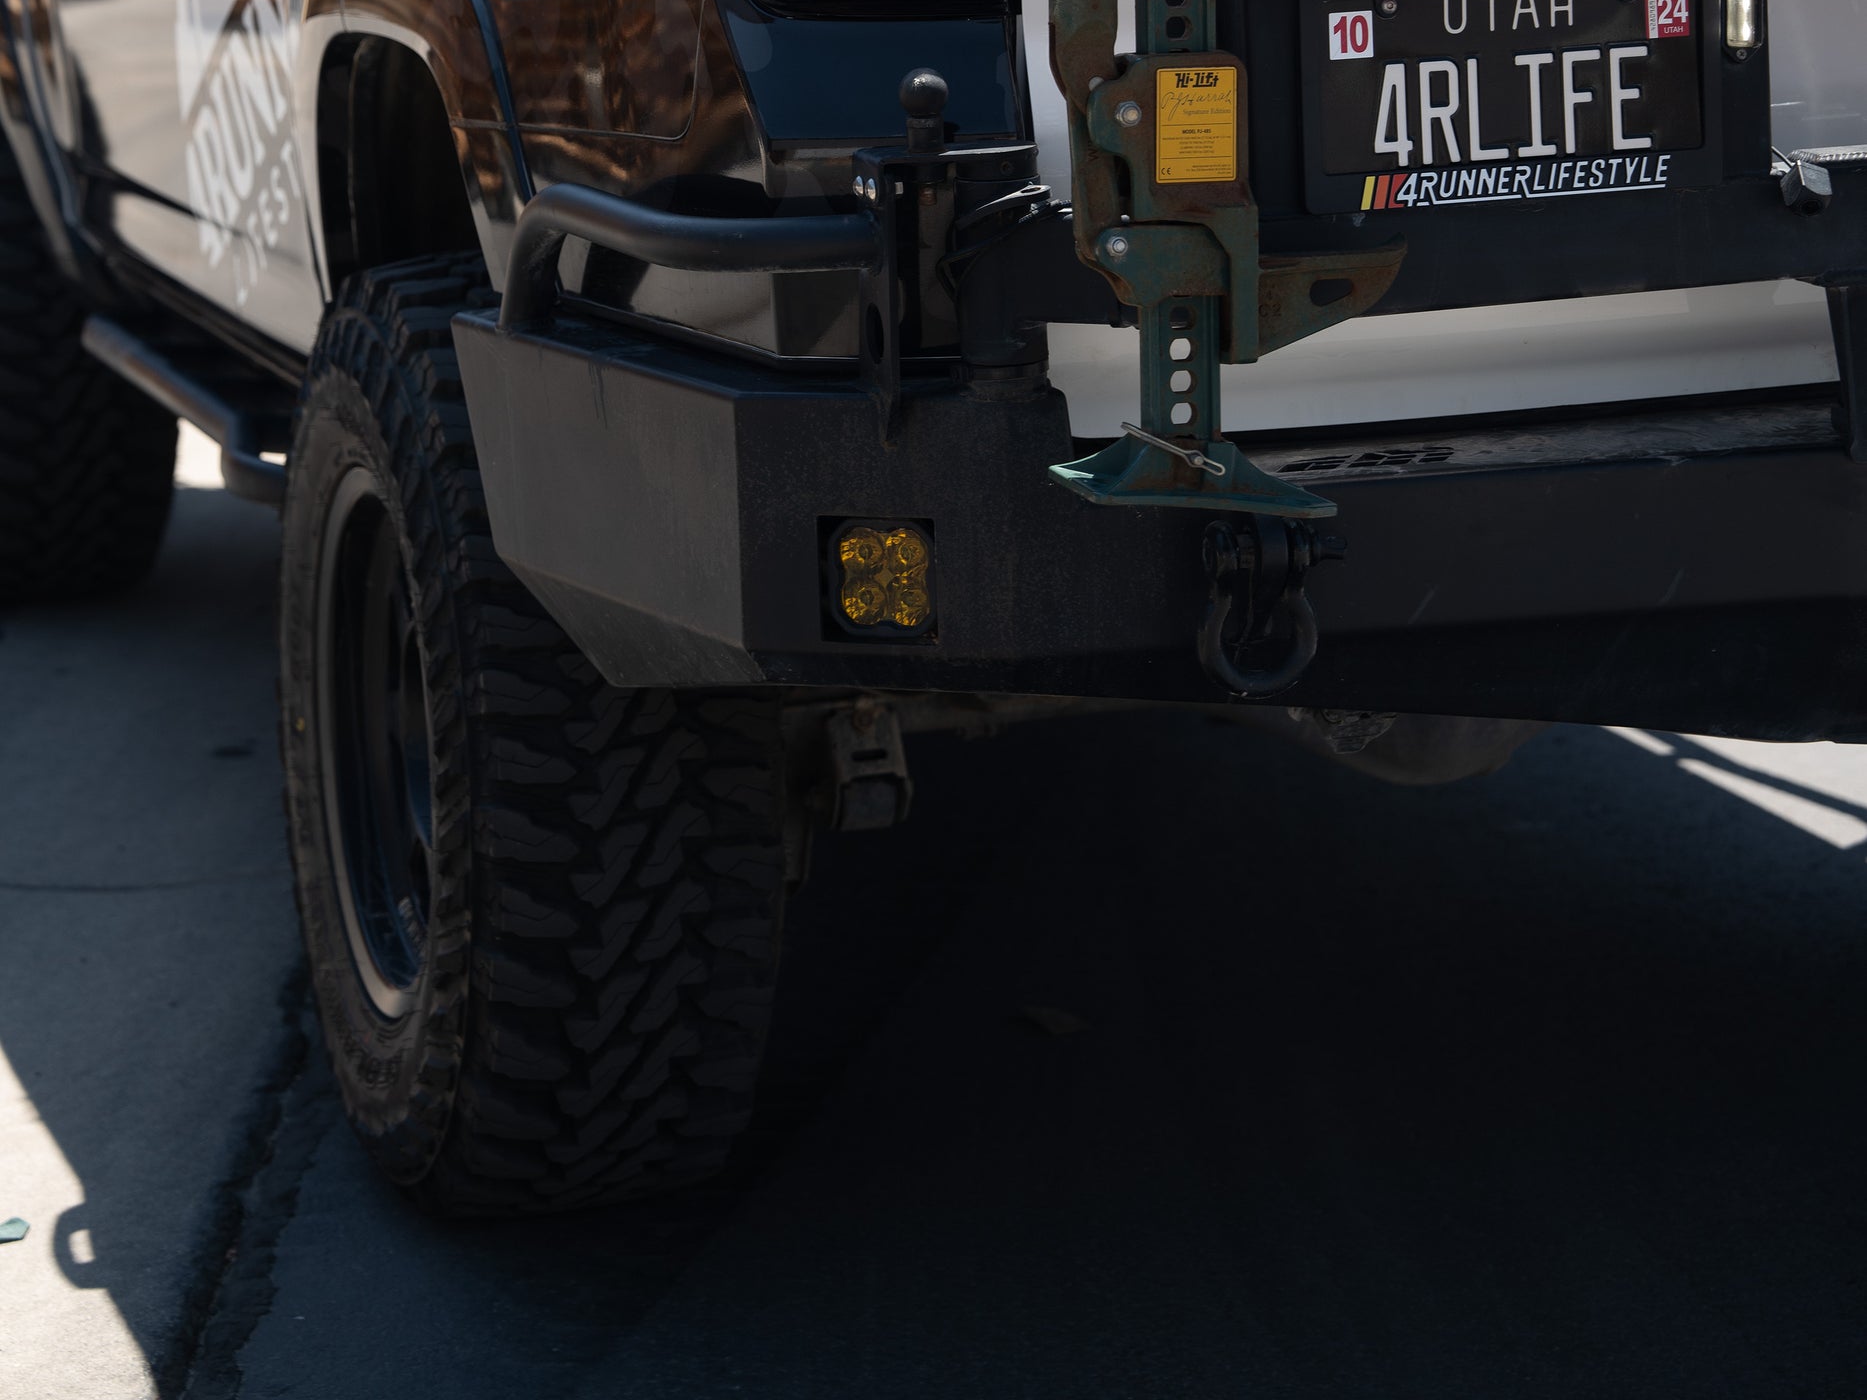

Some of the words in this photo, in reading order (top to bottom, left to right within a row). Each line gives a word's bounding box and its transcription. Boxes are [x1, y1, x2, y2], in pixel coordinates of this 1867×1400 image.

[1333, 14, 1369, 54] 10
[1663, 26, 1684, 34] UTAH
[1175, 71, 1220, 89] Hi-Lift
[1374, 44, 1653, 167] 4RLIFE
[1395, 155, 1672, 207] 4RUNNERLIFESTYLE
